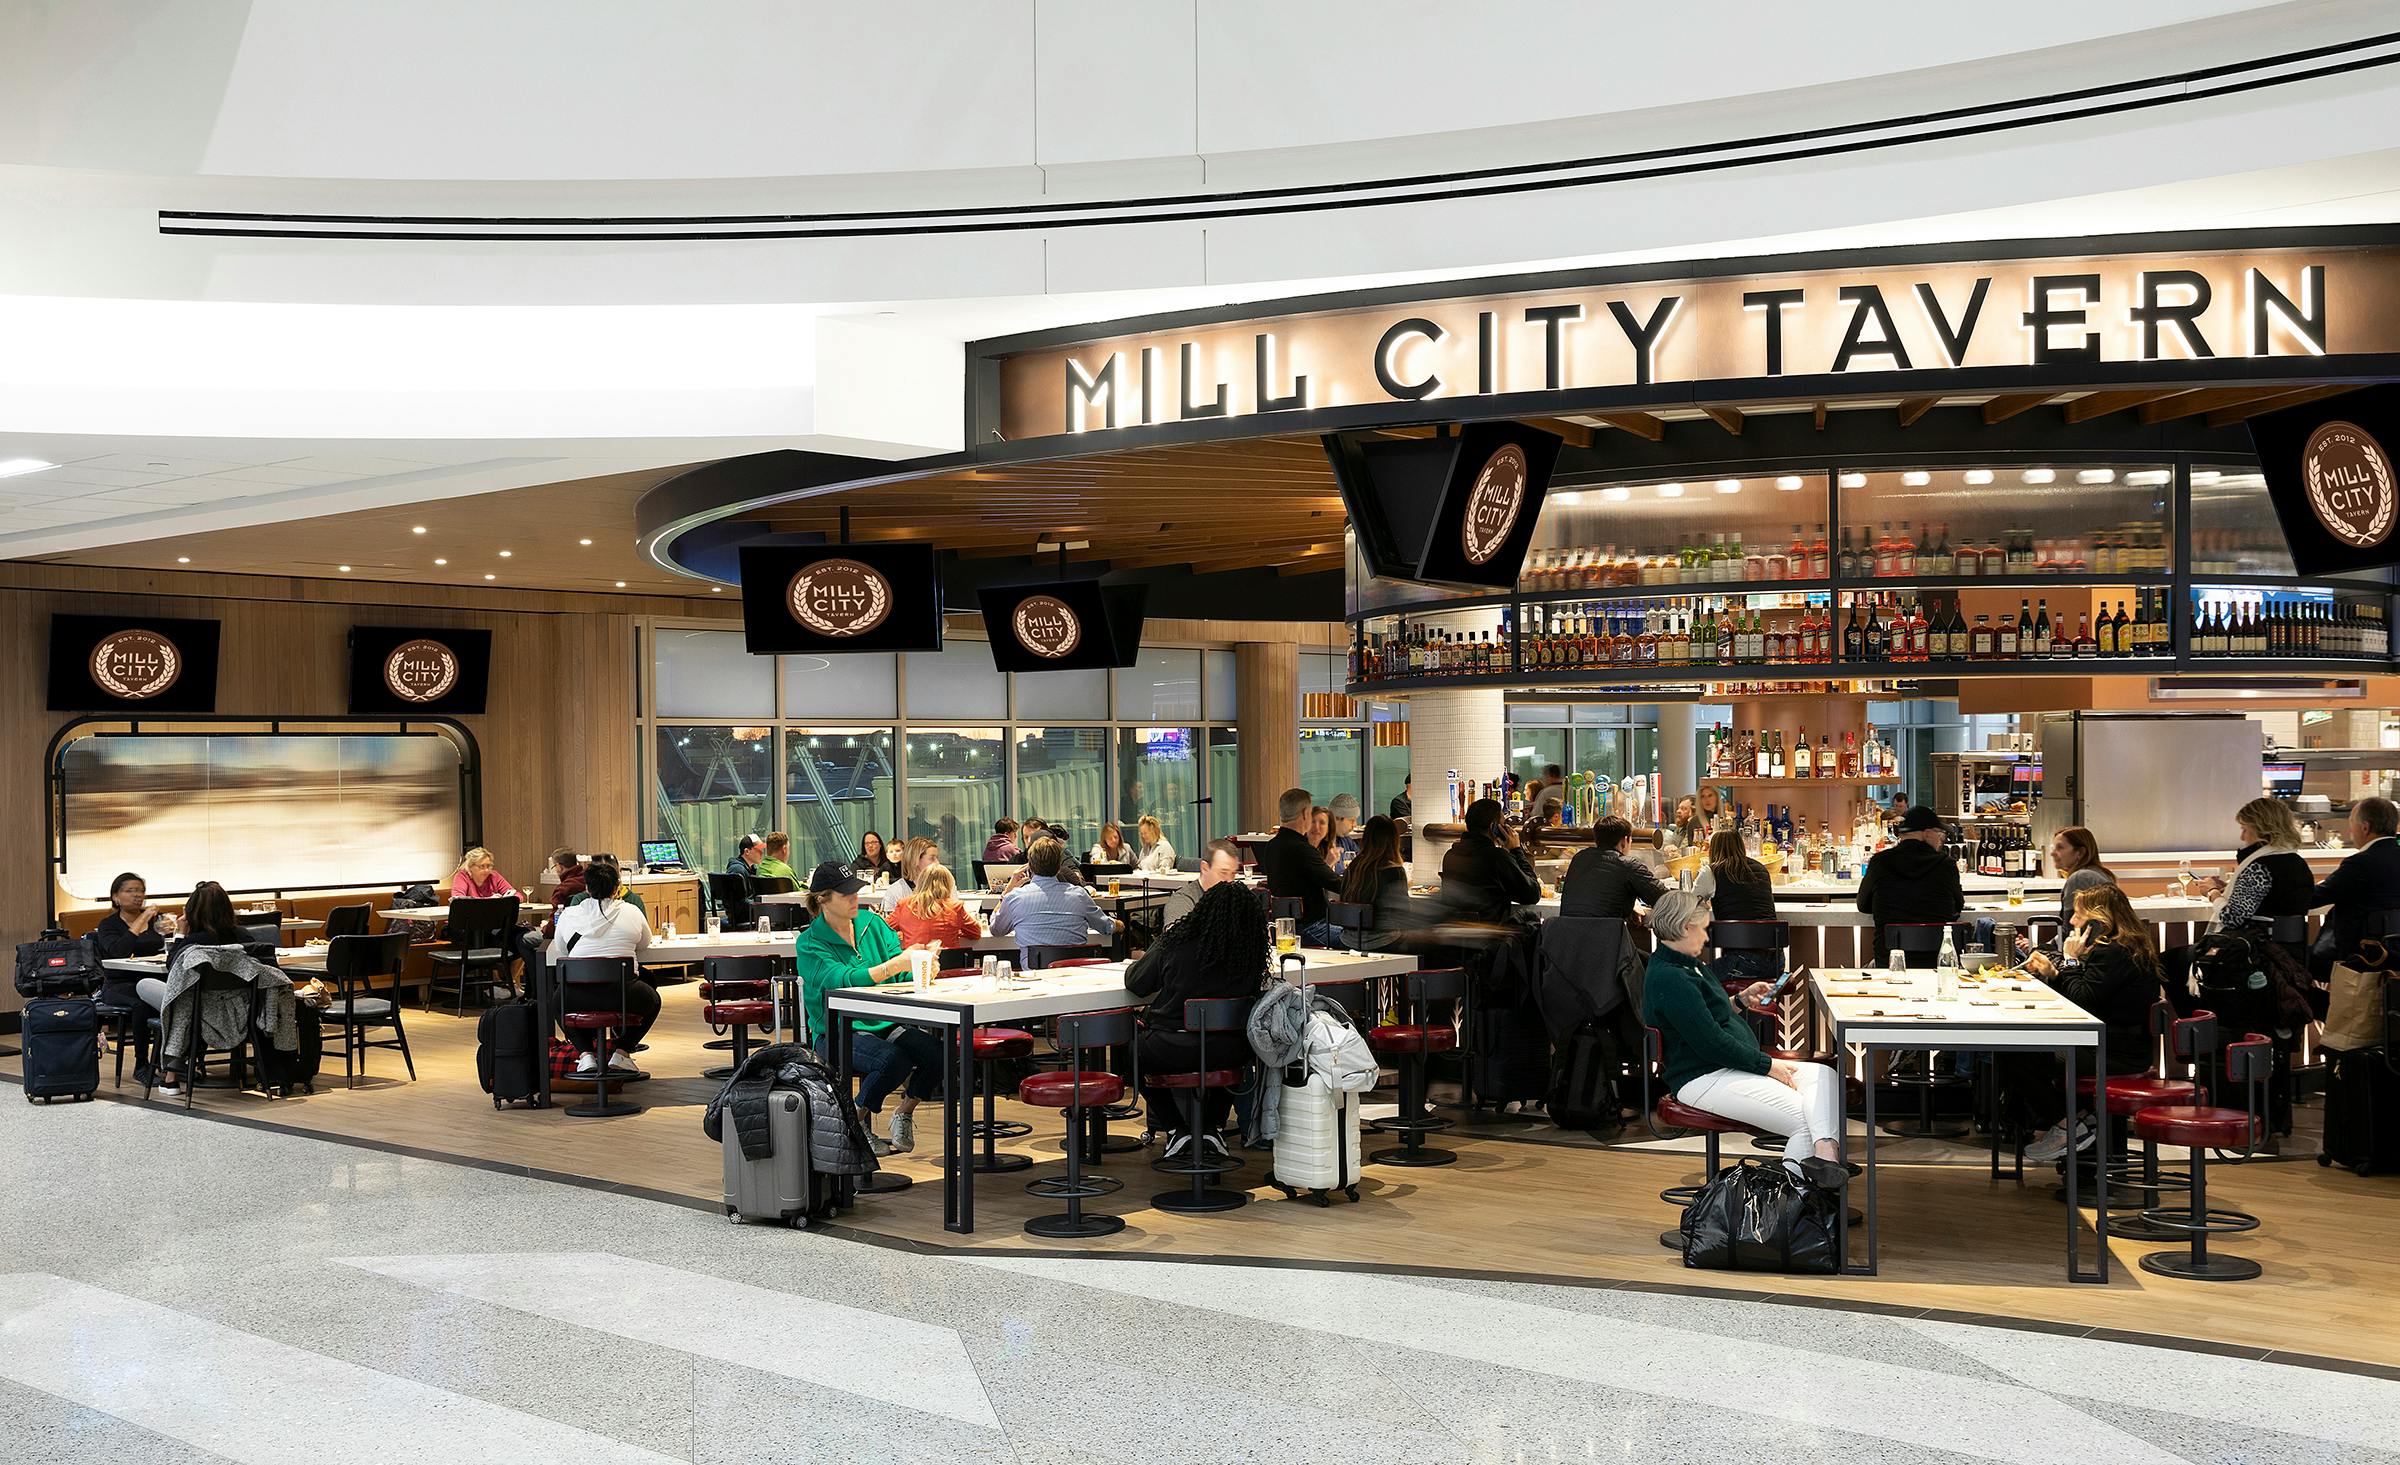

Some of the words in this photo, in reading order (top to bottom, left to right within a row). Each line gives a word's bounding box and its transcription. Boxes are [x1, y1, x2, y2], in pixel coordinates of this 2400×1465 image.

[1066, 333, 1311, 434] MILL
[1374, 296, 1684, 400] CITY
[1743, 266, 2326, 376] TAVERN
[2318, 437, 2333, 451] EST.
[2335, 434, 2356, 444] 2012
[2323, 464, 2371, 489] MILL
[1483, 483, 1511, 506] MILL
[2331, 485, 2373, 510] CITY
[1477, 505, 1507, 526] CITY
[2345, 509, 2370, 518] TAVERN
[836, 566, 859, 574] 2012
[813, 585, 865, 597] MILL
[813, 599, 866, 611] CITY
[1028, 616, 1062, 627] MILL
[1031, 627, 1063, 638] CITY
[113, 653, 159, 664] MILL
[112, 665, 158, 676] CITY
[403, 661, 440, 670] MILL
[402, 672, 440, 681] CITY
